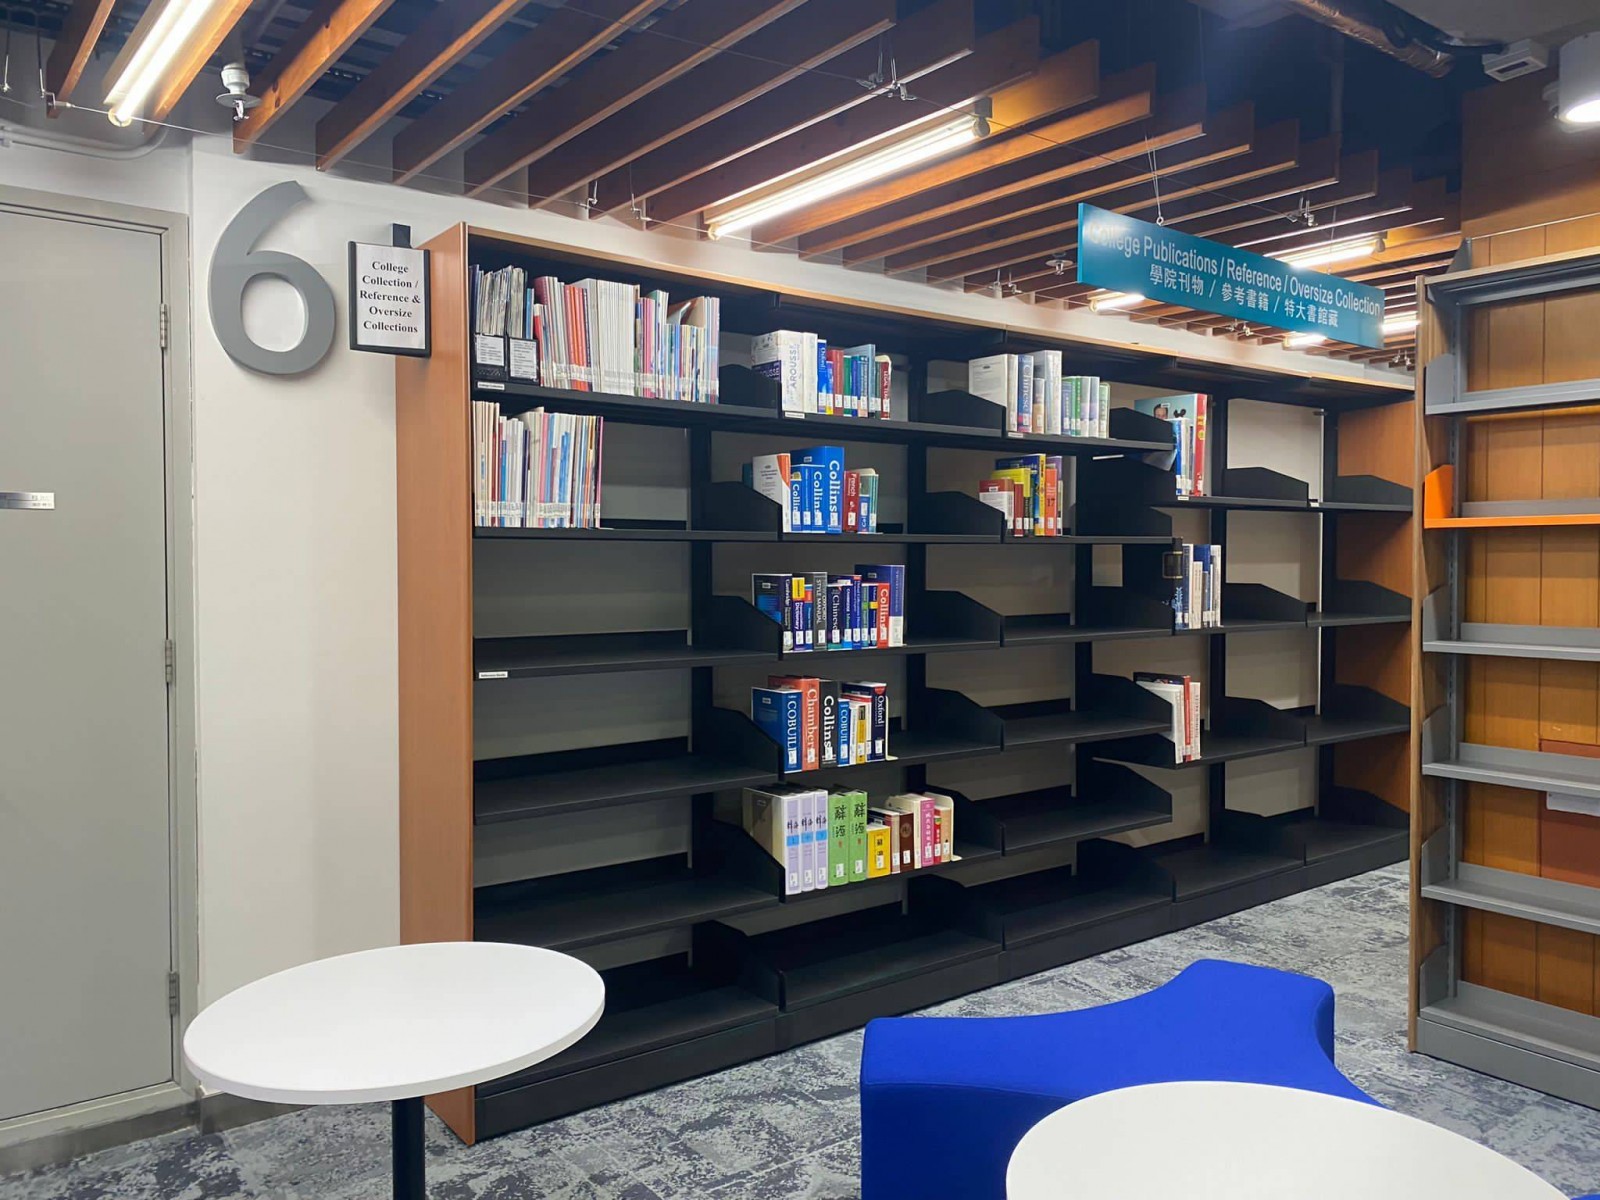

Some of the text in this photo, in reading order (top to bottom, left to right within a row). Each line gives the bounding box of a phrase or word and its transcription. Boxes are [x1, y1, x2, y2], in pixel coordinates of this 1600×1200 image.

[208, 180, 336, 375] 6
[362, 274, 412, 288] Collection
[372, 260, 409, 274] College
[1088, 223, 1141, 260] College
[1144, 236, 1218, 277] Publications
[1227, 259, 1282, 293] Reference
[1290, 276, 1333, 305] Oversize
[1335, 288, 1380, 317] Collection
[360, 289, 421, 304] Reference &
[369, 305, 412, 318] Oversize
[1149, 263, 1204, 297] 學院刊物
[1221, 283, 1269, 312] 參考書籍
[1285, 298, 1339, 327] 特大書館藏
[363, 320, 418, 333] Collections
[1023, 364, 1031, 412] Chinese
[792, 483, 800, 511] Collin
[829, 460, 841, 512] Collins
[832, 594, 840, 630] Chinese
[787, 700, 797, 752] COBUIL
[807, 688, 819, 749] Chamber
[824, 695, 835, 747] Collins
[840, 709, 848, 744] COBUIL
[877, 695, 885, 724] Oxford
